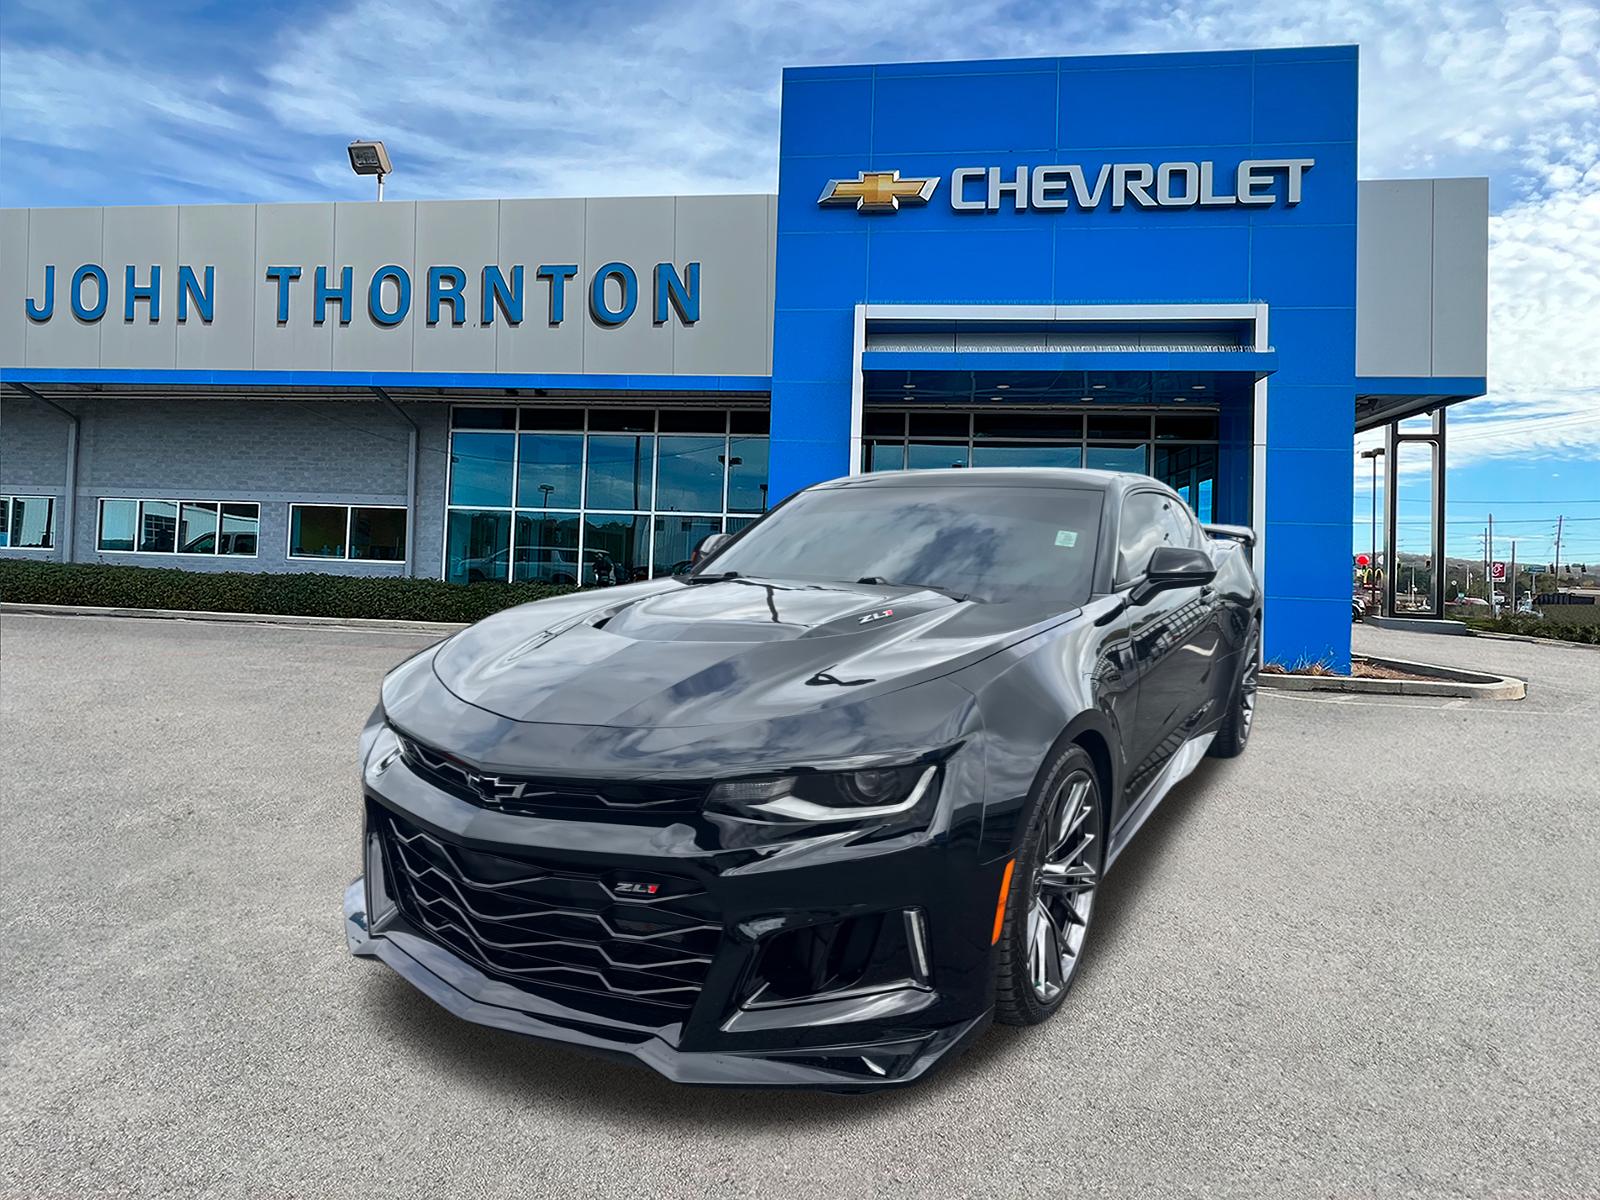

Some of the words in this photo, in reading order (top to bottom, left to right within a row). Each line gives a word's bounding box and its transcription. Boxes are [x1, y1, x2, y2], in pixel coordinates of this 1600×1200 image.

[950, 158, 1315, 211] CHEVROLET
[25, 263, 215, 323] JOHN
[265, 262, 702, 328] THORNTON
[858, 609, 894, 625] ZL1
[614, 882, 660, 895] ZL1
